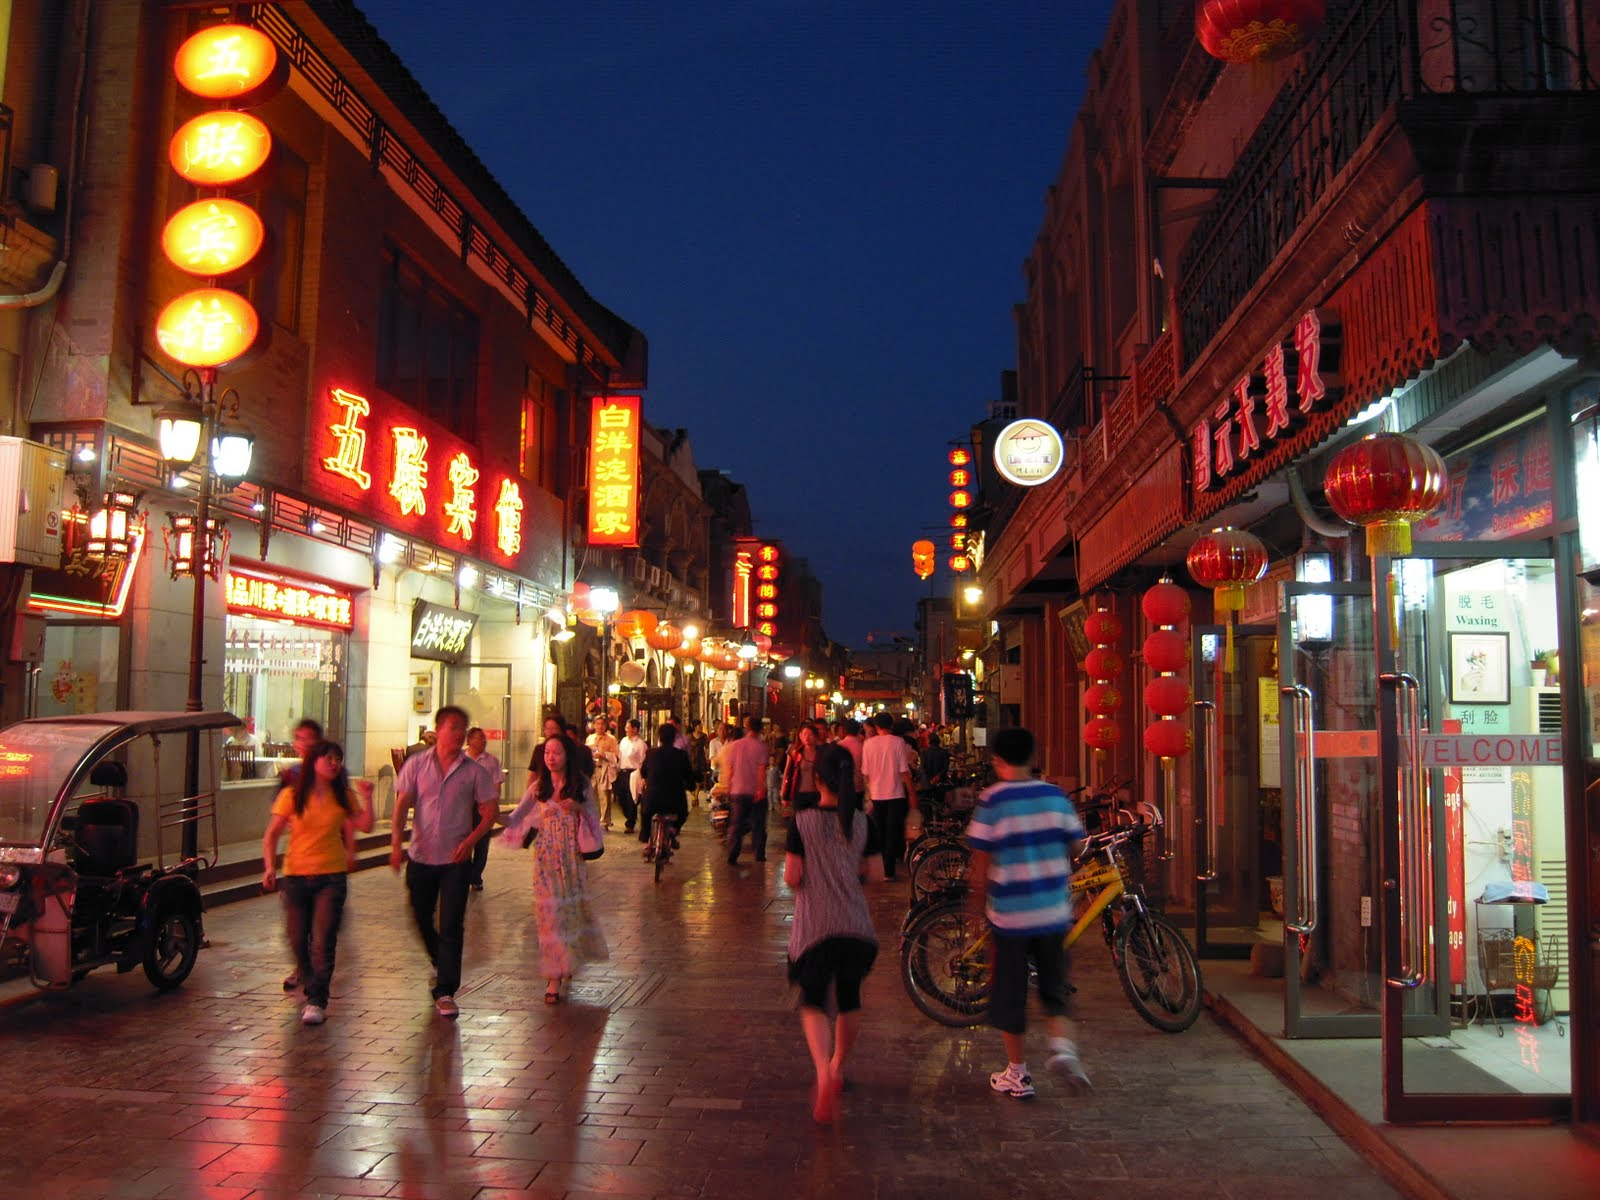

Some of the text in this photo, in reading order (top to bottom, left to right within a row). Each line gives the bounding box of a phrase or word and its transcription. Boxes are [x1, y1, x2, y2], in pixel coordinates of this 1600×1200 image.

[593, 404, 633, 535] 白洋淀酒家
[1458, 594, 1495, 609] 脱毛
[1455, 615, 1498, 627] Waxing
[1460, 709, 1499, 725] 刮脸
[1403, 738, 1562, 763] WELCOME
